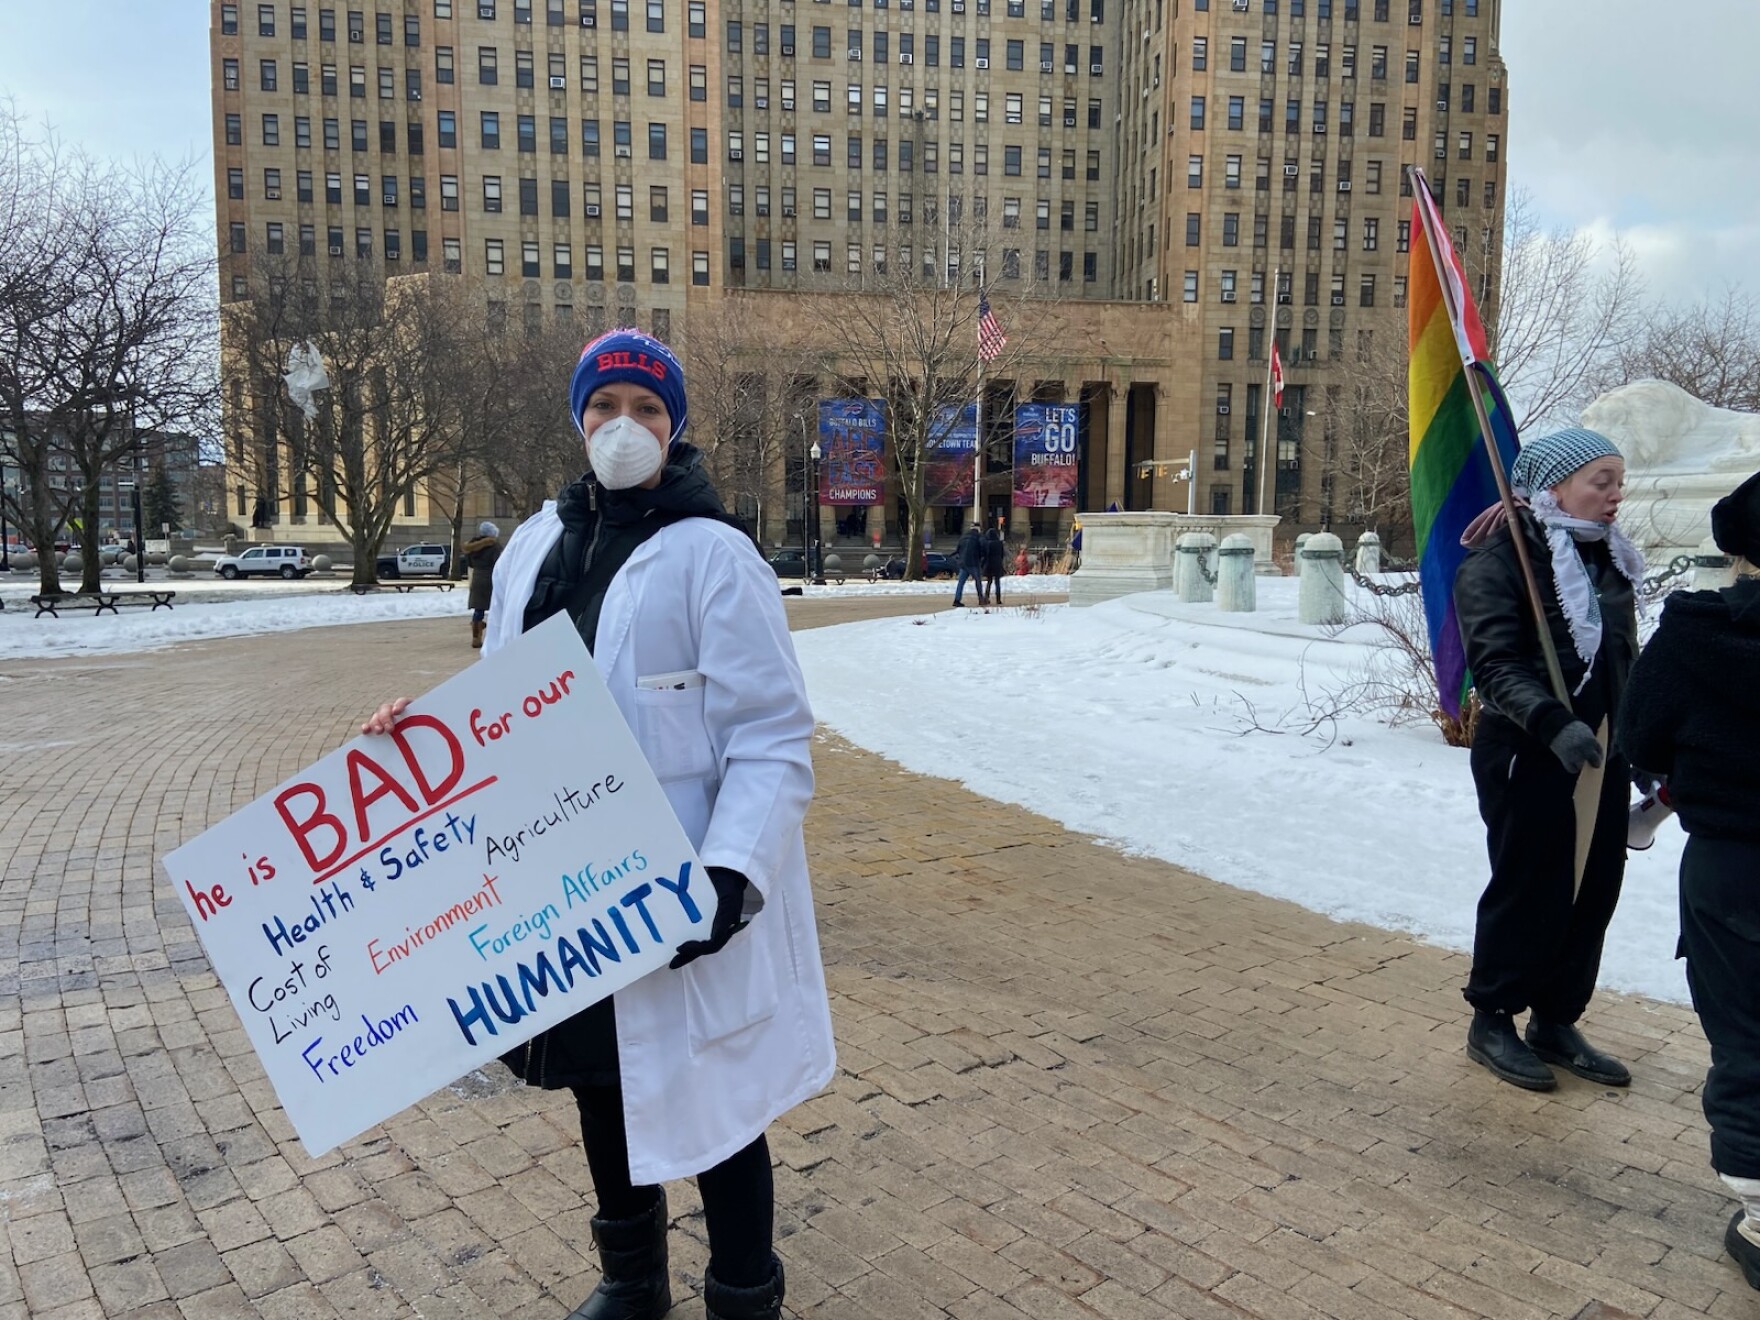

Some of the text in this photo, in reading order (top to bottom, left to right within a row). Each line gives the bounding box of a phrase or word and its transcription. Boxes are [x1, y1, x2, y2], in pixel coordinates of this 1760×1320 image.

[597, 351, 667, 380] BILLS
[858, 418, 877, 428] BILLS
[1045, 408, 1075, 422] LET'S
[1045, 423, 1075, 452] GO
[1031, 453, 1076, 466] BUFFALO!
[829, 489, 877, 500] CHAMPIONS
[186, 670, 575, 922] he is BAD for our
[487, 774, 624, 866] Agriculture
[264, 813, 477, 956] Health & Safety
[469, 849, 648, 962] Foreign Affairs
[367, 873, 502, 975] Environment
[447, 862, 704, 1046] HUMANITY
[247, 945, 331, 1013] Cost of
[271, 994, 341, 1044] Living
[302, 1005, 419, 1083] Freedom
